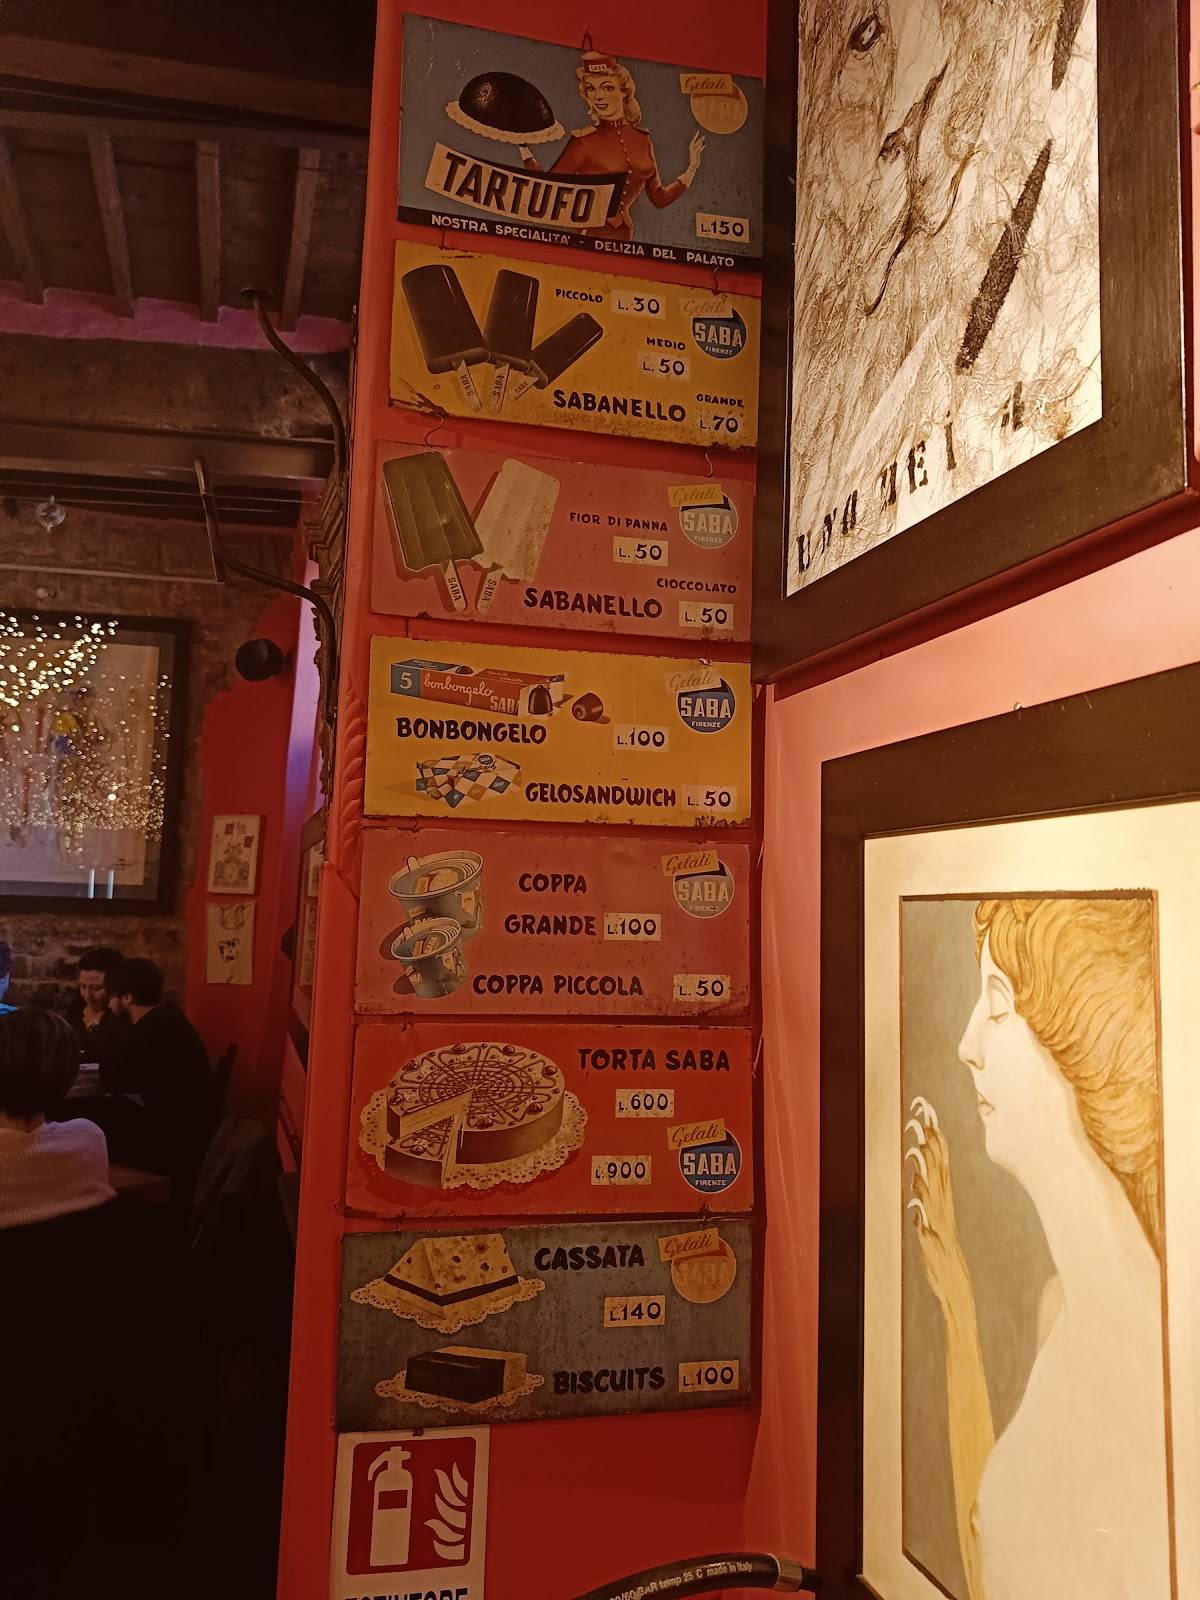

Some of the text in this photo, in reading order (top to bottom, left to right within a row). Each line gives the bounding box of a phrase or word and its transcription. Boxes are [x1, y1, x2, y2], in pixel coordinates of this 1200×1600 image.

[444, 152, 596, 224] TARTUFO
[431, 214, 488, 234] NOSTRA
[594, 239, 645, 256] DELIZIA
[652, 246, 677, 260] DEL
[686, 251, 735, 268] PALATO
[555, 288, 603, 304] PICCOLO
[646, 336, 686, 351] MEDIO
[694, 322, 743, 348] SABA
[705, 346, 733, 355] FIRENZE
[553, 389, 686, 423] SABANELLO
[696, 393, 744, 408] GRANDE
[569, 512, 668, 532] FIOR DI PANNA
[683, 511, 733, 536] SABA
[694, 535, 722, 544] FIRENZE
[447, 577, 463, 601] SABA
[656, 577, 737, 594] CIOCCOLATO
[523, 587, 663, 620] SABANELLO
[399, 671, 413, 690] 5
[423, 671, 494, 706] bonbongelo
[680, 697, 732, 719] SABA
[397, 717, 547, 745] BONBONGELO
[691, 720, 722, 728] FIRENZE
[525, 782, 677, 808] GELOSANDWICH
[666, 852, 712, 875] Gelati
[519, 873, 587, 895] COPPA
[678, 880, 729, 902] SABA
[504, 914, 597, 937] GRANDE
[472, 974, 643, 997] COPPA PICCOLA
[578, 1047, 731, 1072] TORTA SABA
[672, 1123, 720, 1147] Gelati
[683, 1152, 737, 1175] SABA
[695, 1179, 727, 1187] FIRENZE
[664, 1232, 713, 1258] Gelati
[534, 1244, 645, 1271] CASSATA
[553, 1366, 665, 1395] BISCUITS
[659, 1576, 683, 1591] temp
[707, 1563, 728, 1577] made
[729, 1562, 737, 1573] in
[737, 1561, 753, 1573] Italy
